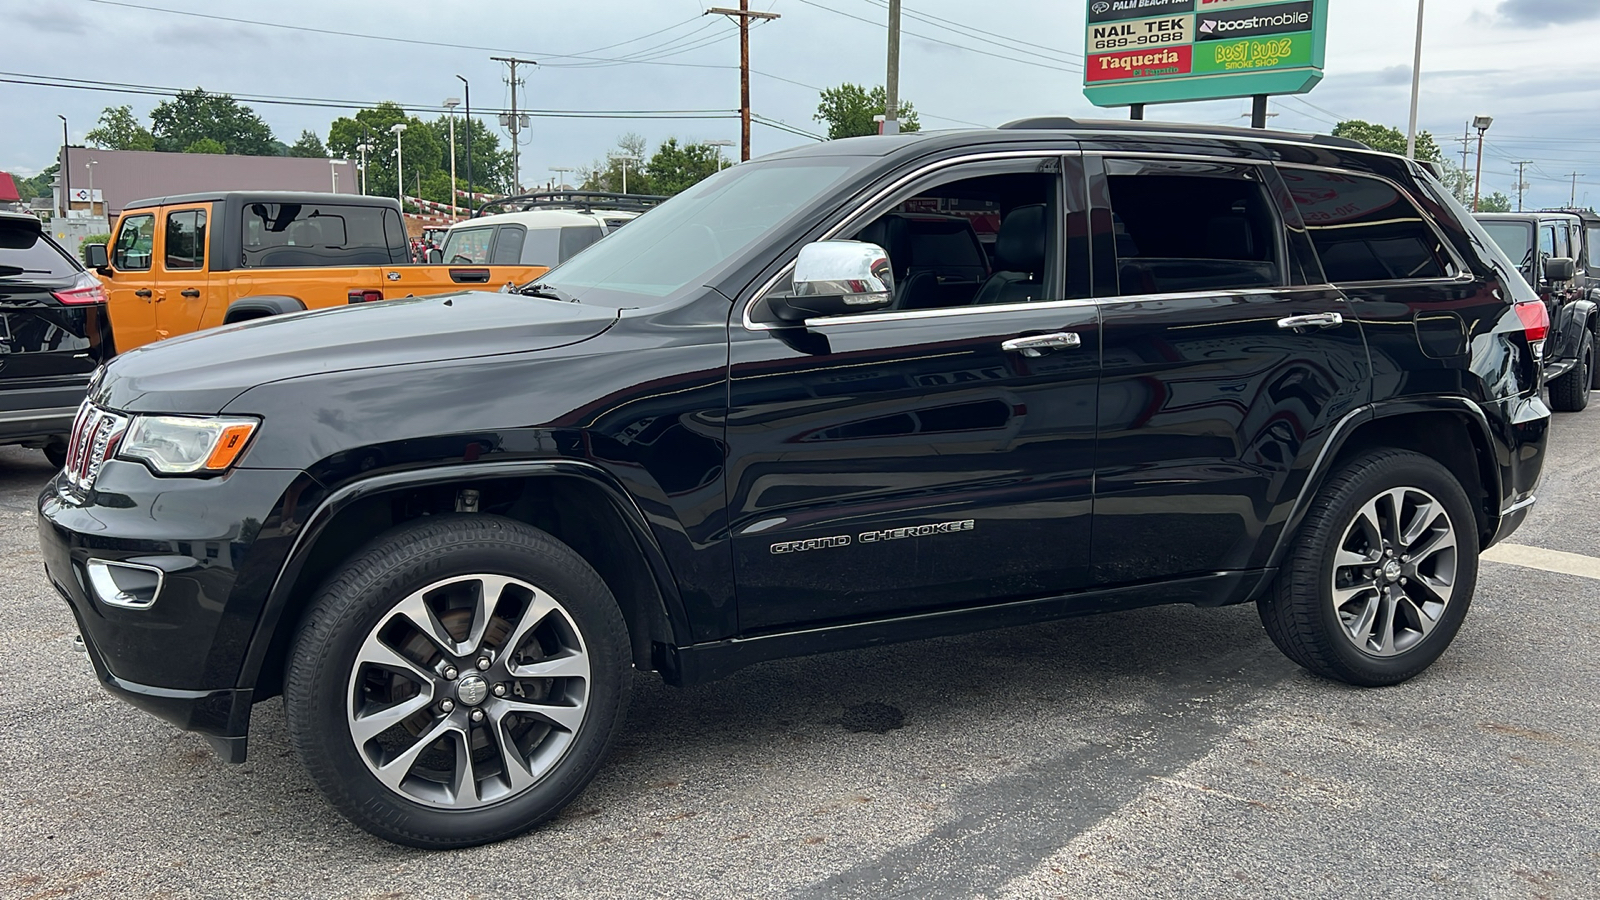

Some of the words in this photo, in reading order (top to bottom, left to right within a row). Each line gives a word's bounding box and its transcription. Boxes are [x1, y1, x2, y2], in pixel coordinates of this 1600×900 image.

[1112, 0, 1137, 11] PALM
[1094, 24, 1136, 39] NAIL
[1144, 18, 1185, 33] TEK
[1217, 12, 1309, 31] boostmobile
[1095, 32, 1183, 49] 689-9088
[1225, 60, 1253, 70] SMOKE
[1255, 58, 1279, 67] SHOP
[770, 535, 851, 554] GRAND
[858, 519, 975, 543] CHEROKEE
